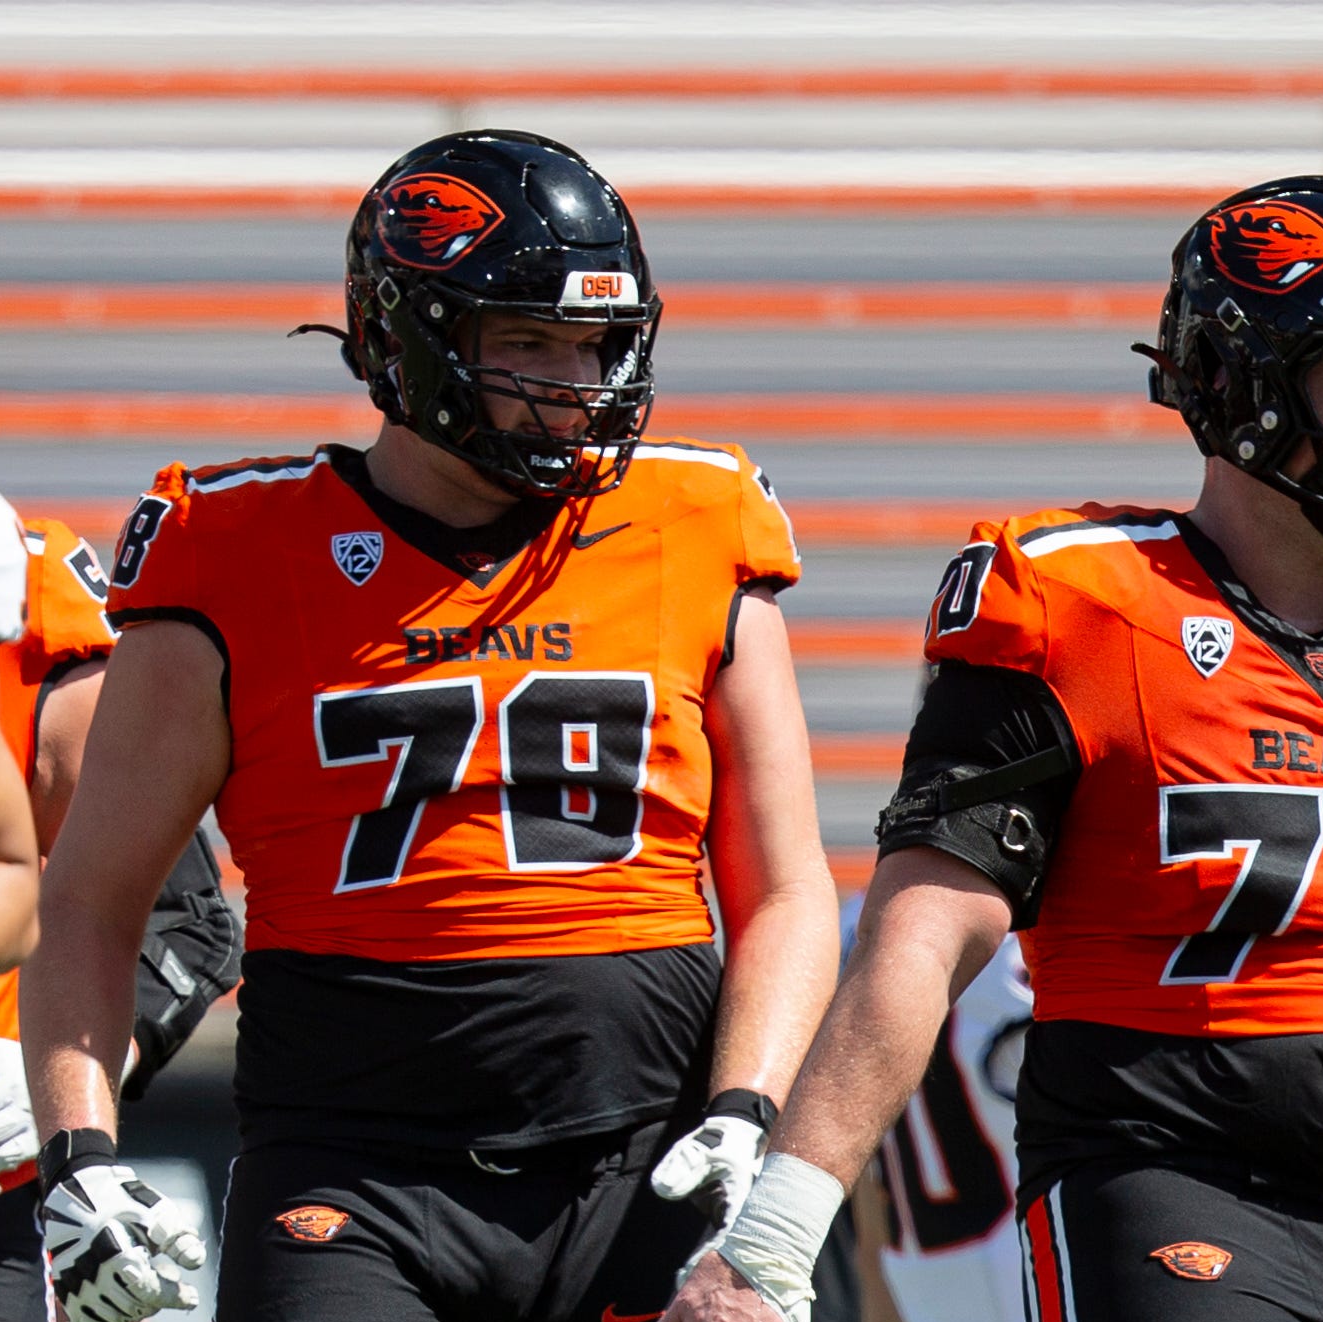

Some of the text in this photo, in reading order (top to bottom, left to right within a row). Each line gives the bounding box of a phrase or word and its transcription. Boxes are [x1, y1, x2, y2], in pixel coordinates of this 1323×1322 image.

[581, 274, 623, 298] OSU
[334, 535, 381, 564] PAC
[346, 553, 371, 574] 12
[402, 622, 574, 665] BEAVS
[1185, 619, 1232, 654] PAC
[1196, 640, 1222, 664] 12
[313, 671, 656, 895] 78
